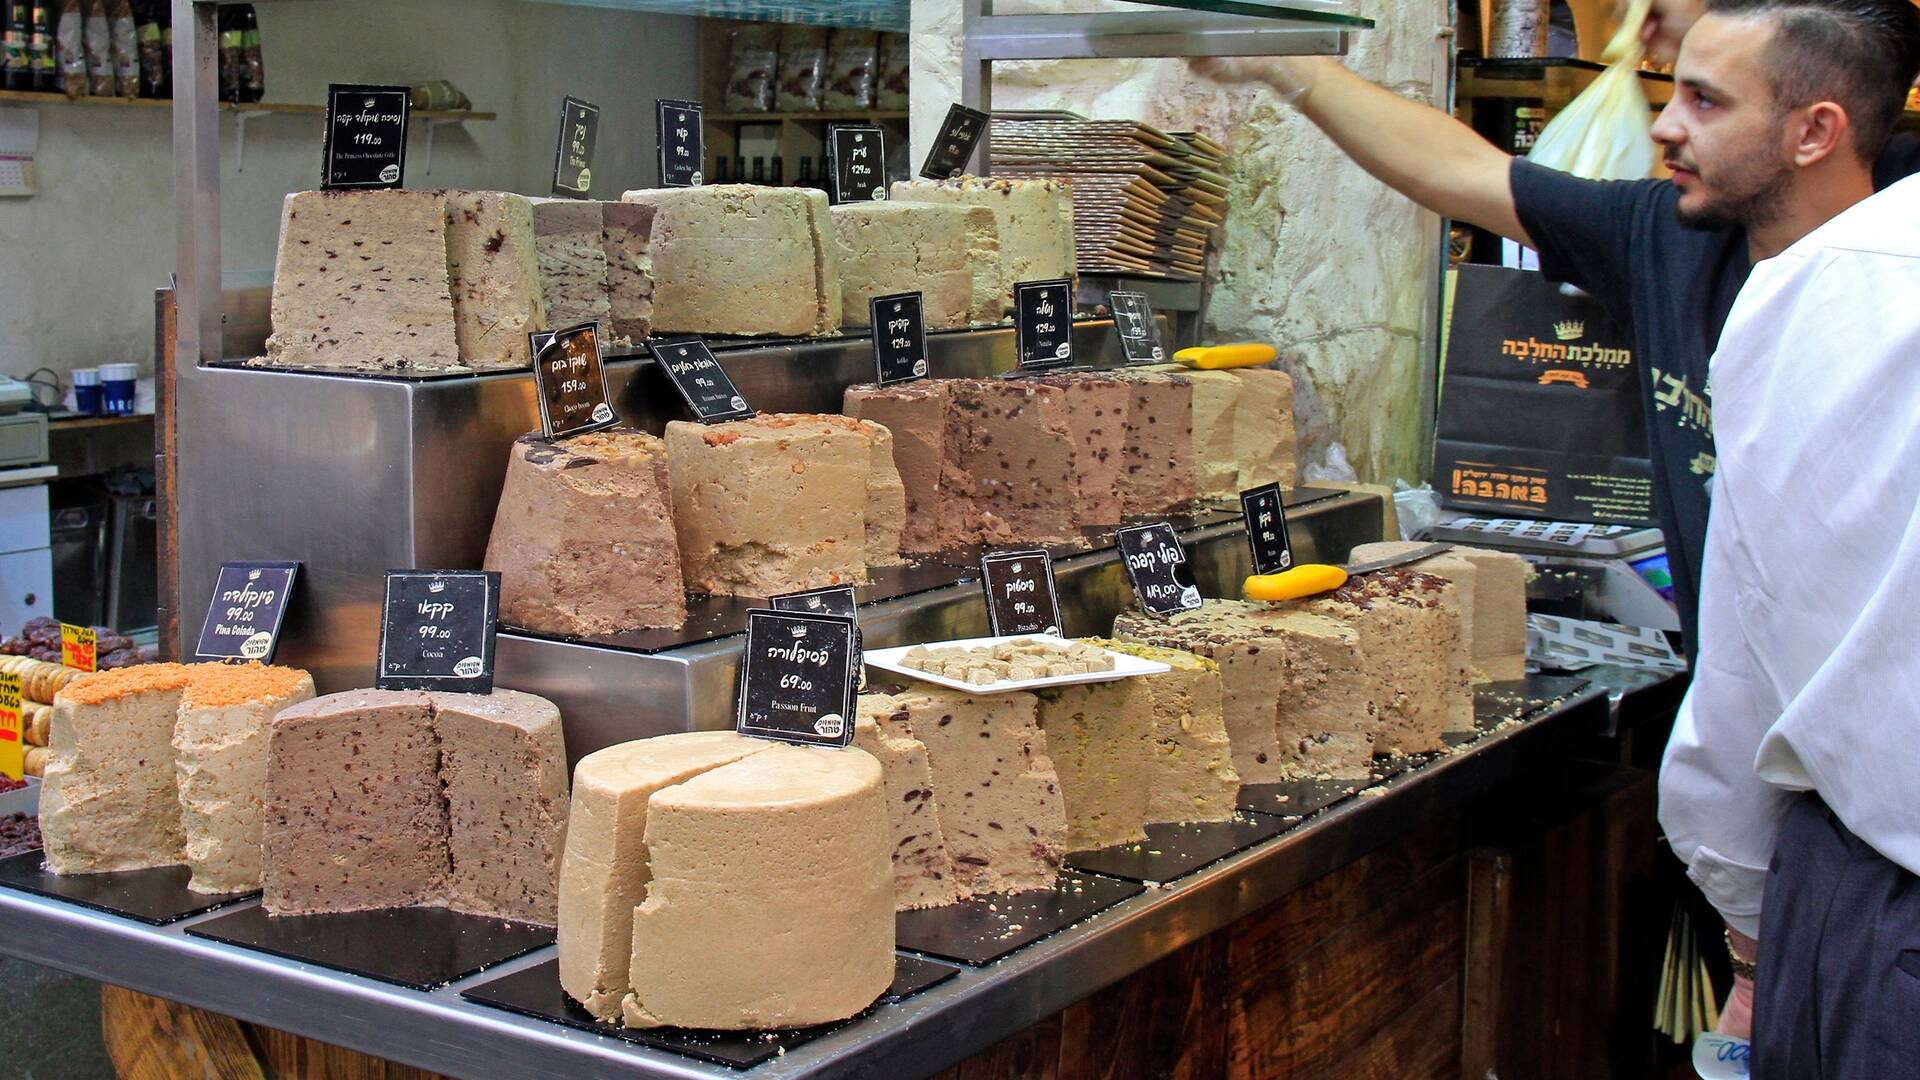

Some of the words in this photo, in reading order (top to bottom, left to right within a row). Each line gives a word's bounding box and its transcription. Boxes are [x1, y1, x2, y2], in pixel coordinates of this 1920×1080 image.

[336, 113, 353, 126] קפה
[355, 109, 380, 126] שוקולד
[381, 113, 402, 126] נסיכה
[353, 133, 382, 145] 119.00
[676, 145, 690, 157] 99.00
[852, 146, 867, 161] ערק
[851, 164, 871, 174] 129.00
[1035, 300, 1054, 318] נוטלה
[1035, 322, 1056, 333] 129.00
[891, 337, 911, 349] 129.00
[551, 360, 567, 373] בום
[569, 353, 587, 374] שוקו
[561, 379, 586, 393] 159.00
[695, 377, 714, 388] 99.00
[1452, 469, 1547, 504] באהבה!
[1157, 542, 1179, 564] פולי
[1129, 551, 1155, 573] קפה
[1005, 578, 1035, 599] פיסטוק
[1146, 584, 1176, 599] 119.00
[222, 582, 275, 610] פינקולדה
[227, 607, 254, 621] 99.00
[417, 599, 455, 620] קקאו
[1014, 602, 1035, 614] 99.00
[215, 623, 230, 635] Pina
[231, 624, 256, 636] Colada
[419, 625, 451, 639] 99.00
[246, 645, 267, 655] טהור
[422, 649, 444, 658] Cocoa
[767, 640, 829, 667] פסיפלורה
[780, 673, 812, 691] 69.00
[771, 699, 799, 712] Passion
[799, 702, 817, 714] Fruit
[819, 725, 840, 734] טהור
